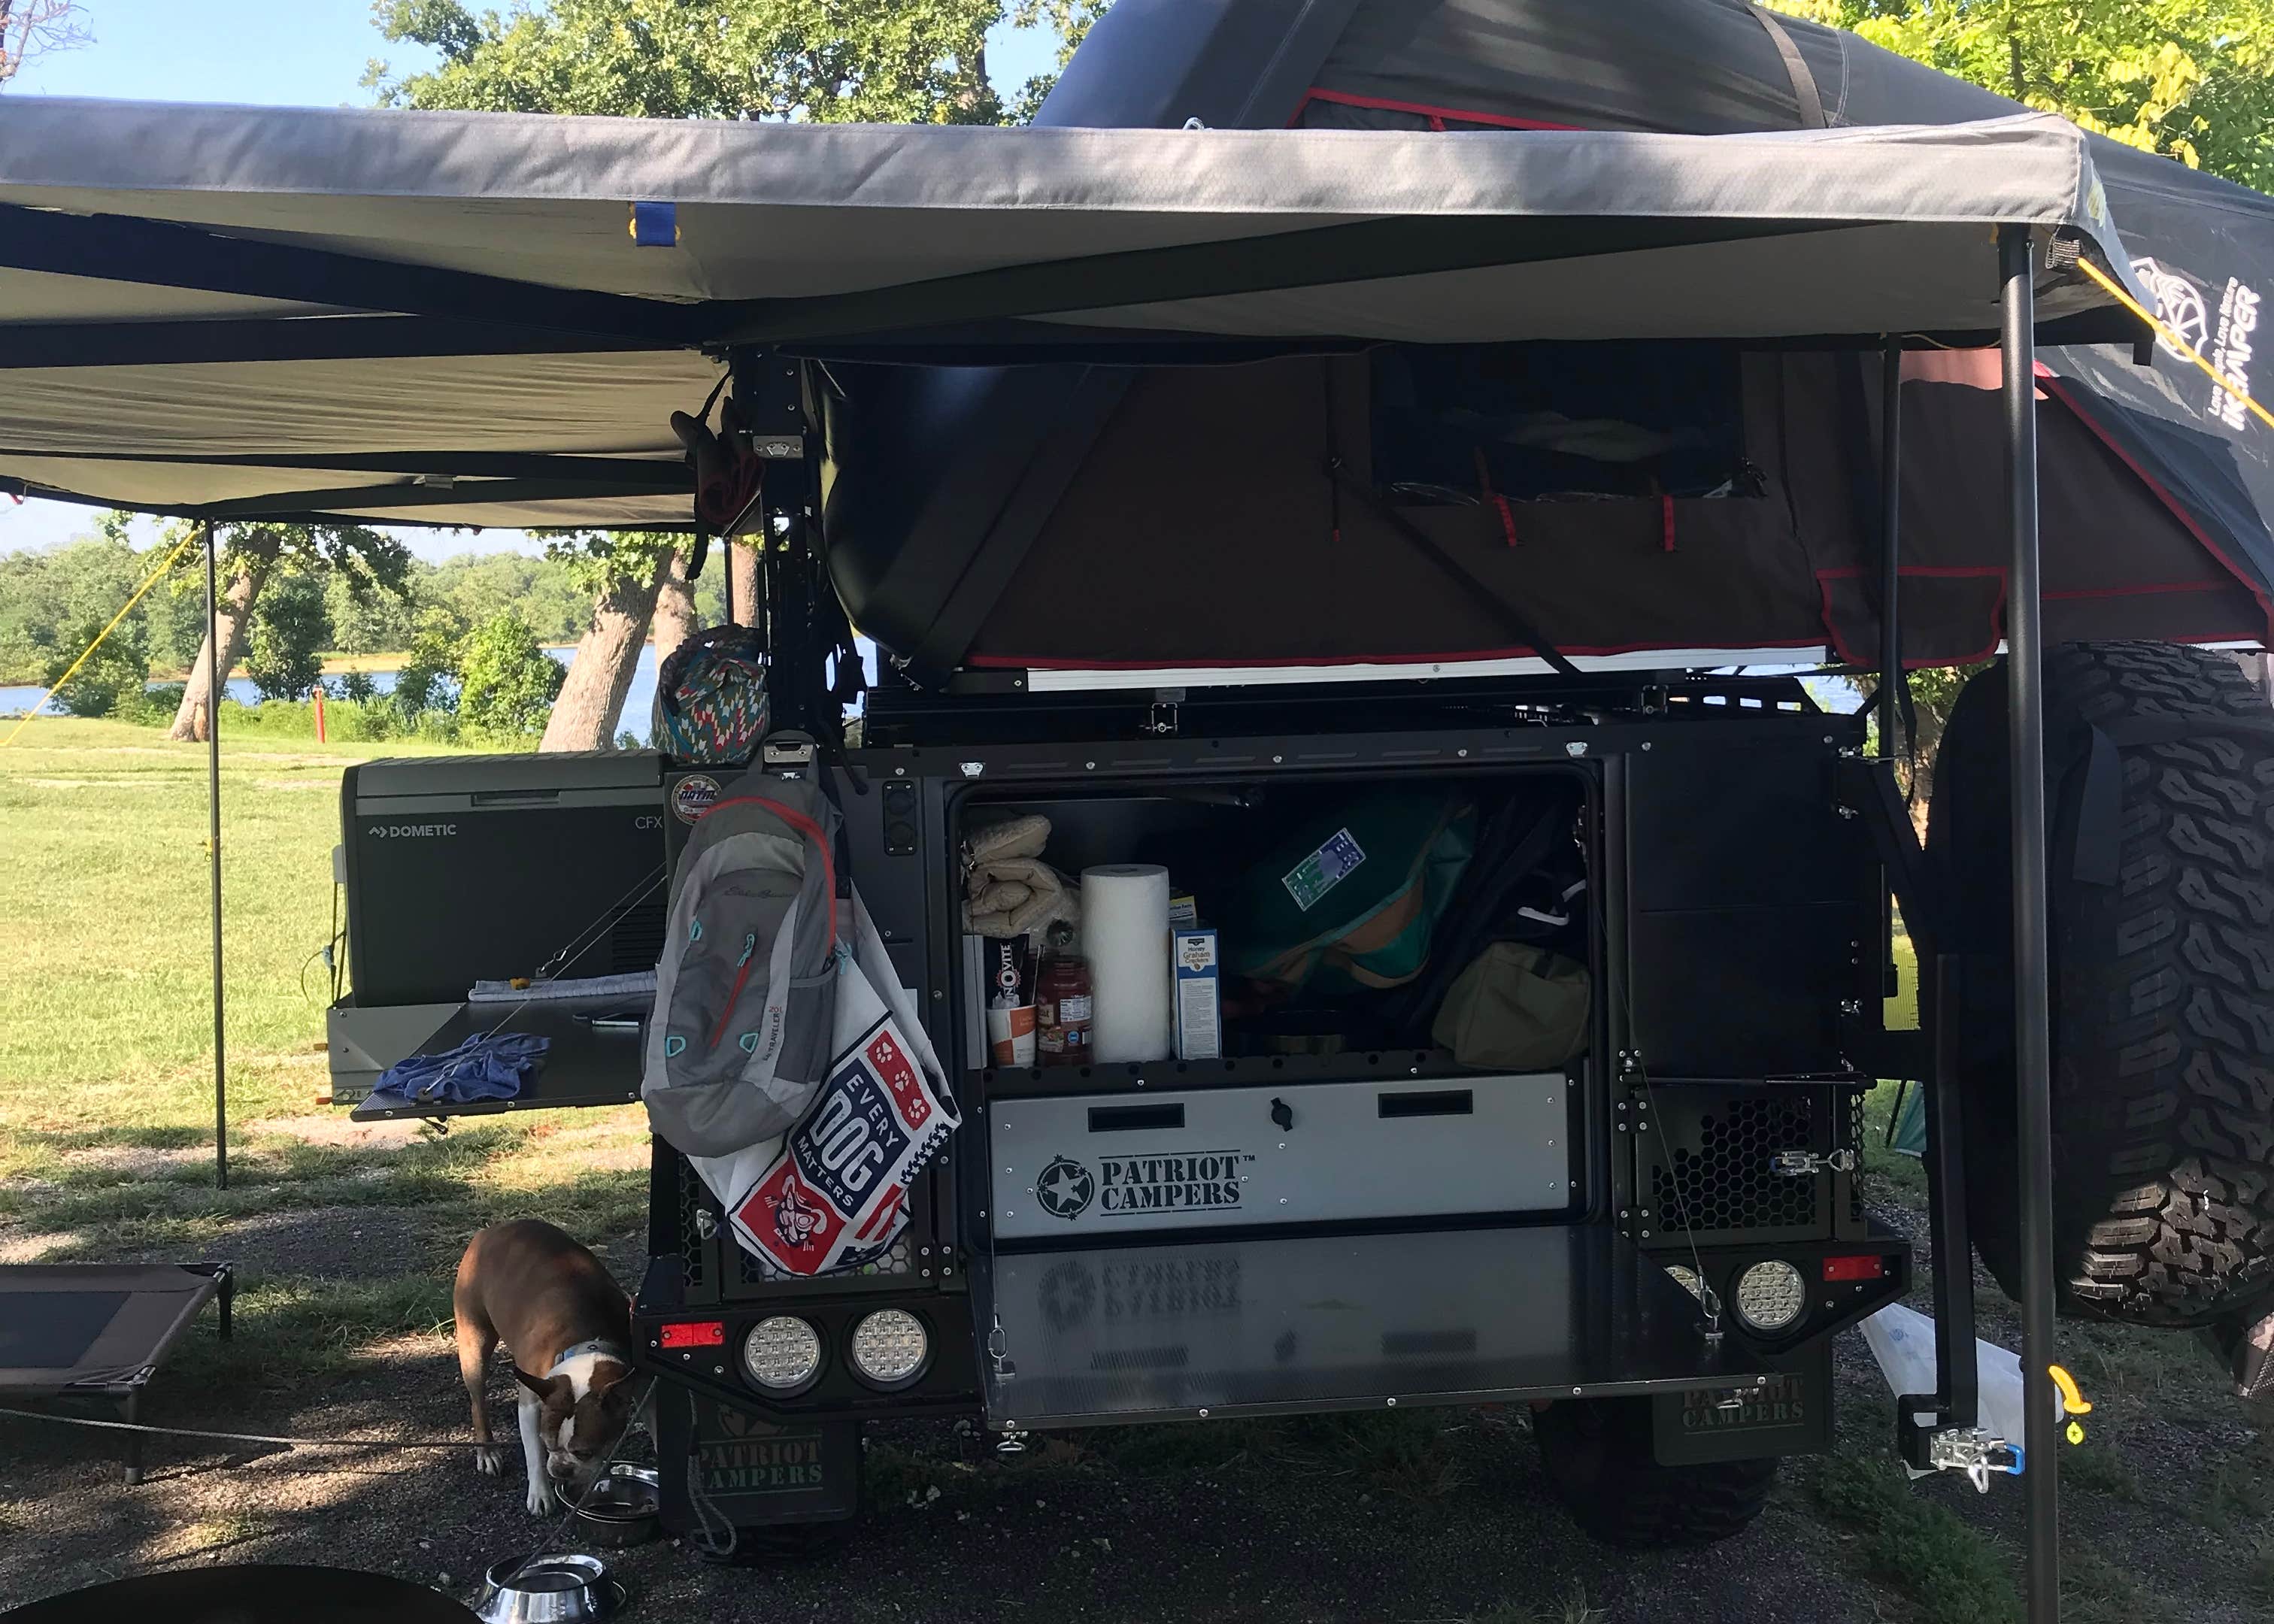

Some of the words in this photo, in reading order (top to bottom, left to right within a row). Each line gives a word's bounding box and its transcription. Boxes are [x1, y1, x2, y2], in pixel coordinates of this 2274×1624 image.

[2218, 276, 2239, 317] Nature
[2214, 317, 2230, 347] Love
[2208, 386, 2222, 417] Love
[390, 824, 457, 838] DOMETIC
[635, 817, 663, 830] CFX
[769, 1013, 781, 1051] TRAVELER
[844, 1073, 899, 1150] EVERY
[807, 1087, 885, 1195] DOG
[796, 1134, 855, 1209] MATTERS
[1101, 1156, 1240, 1186] PATRIOT
[1100, 1180, 1241, 1210] CAMPERS
[1683, 1401, 1804, 1427] CAMPERS
[708, 1463, 823, 1489] AMPERS
